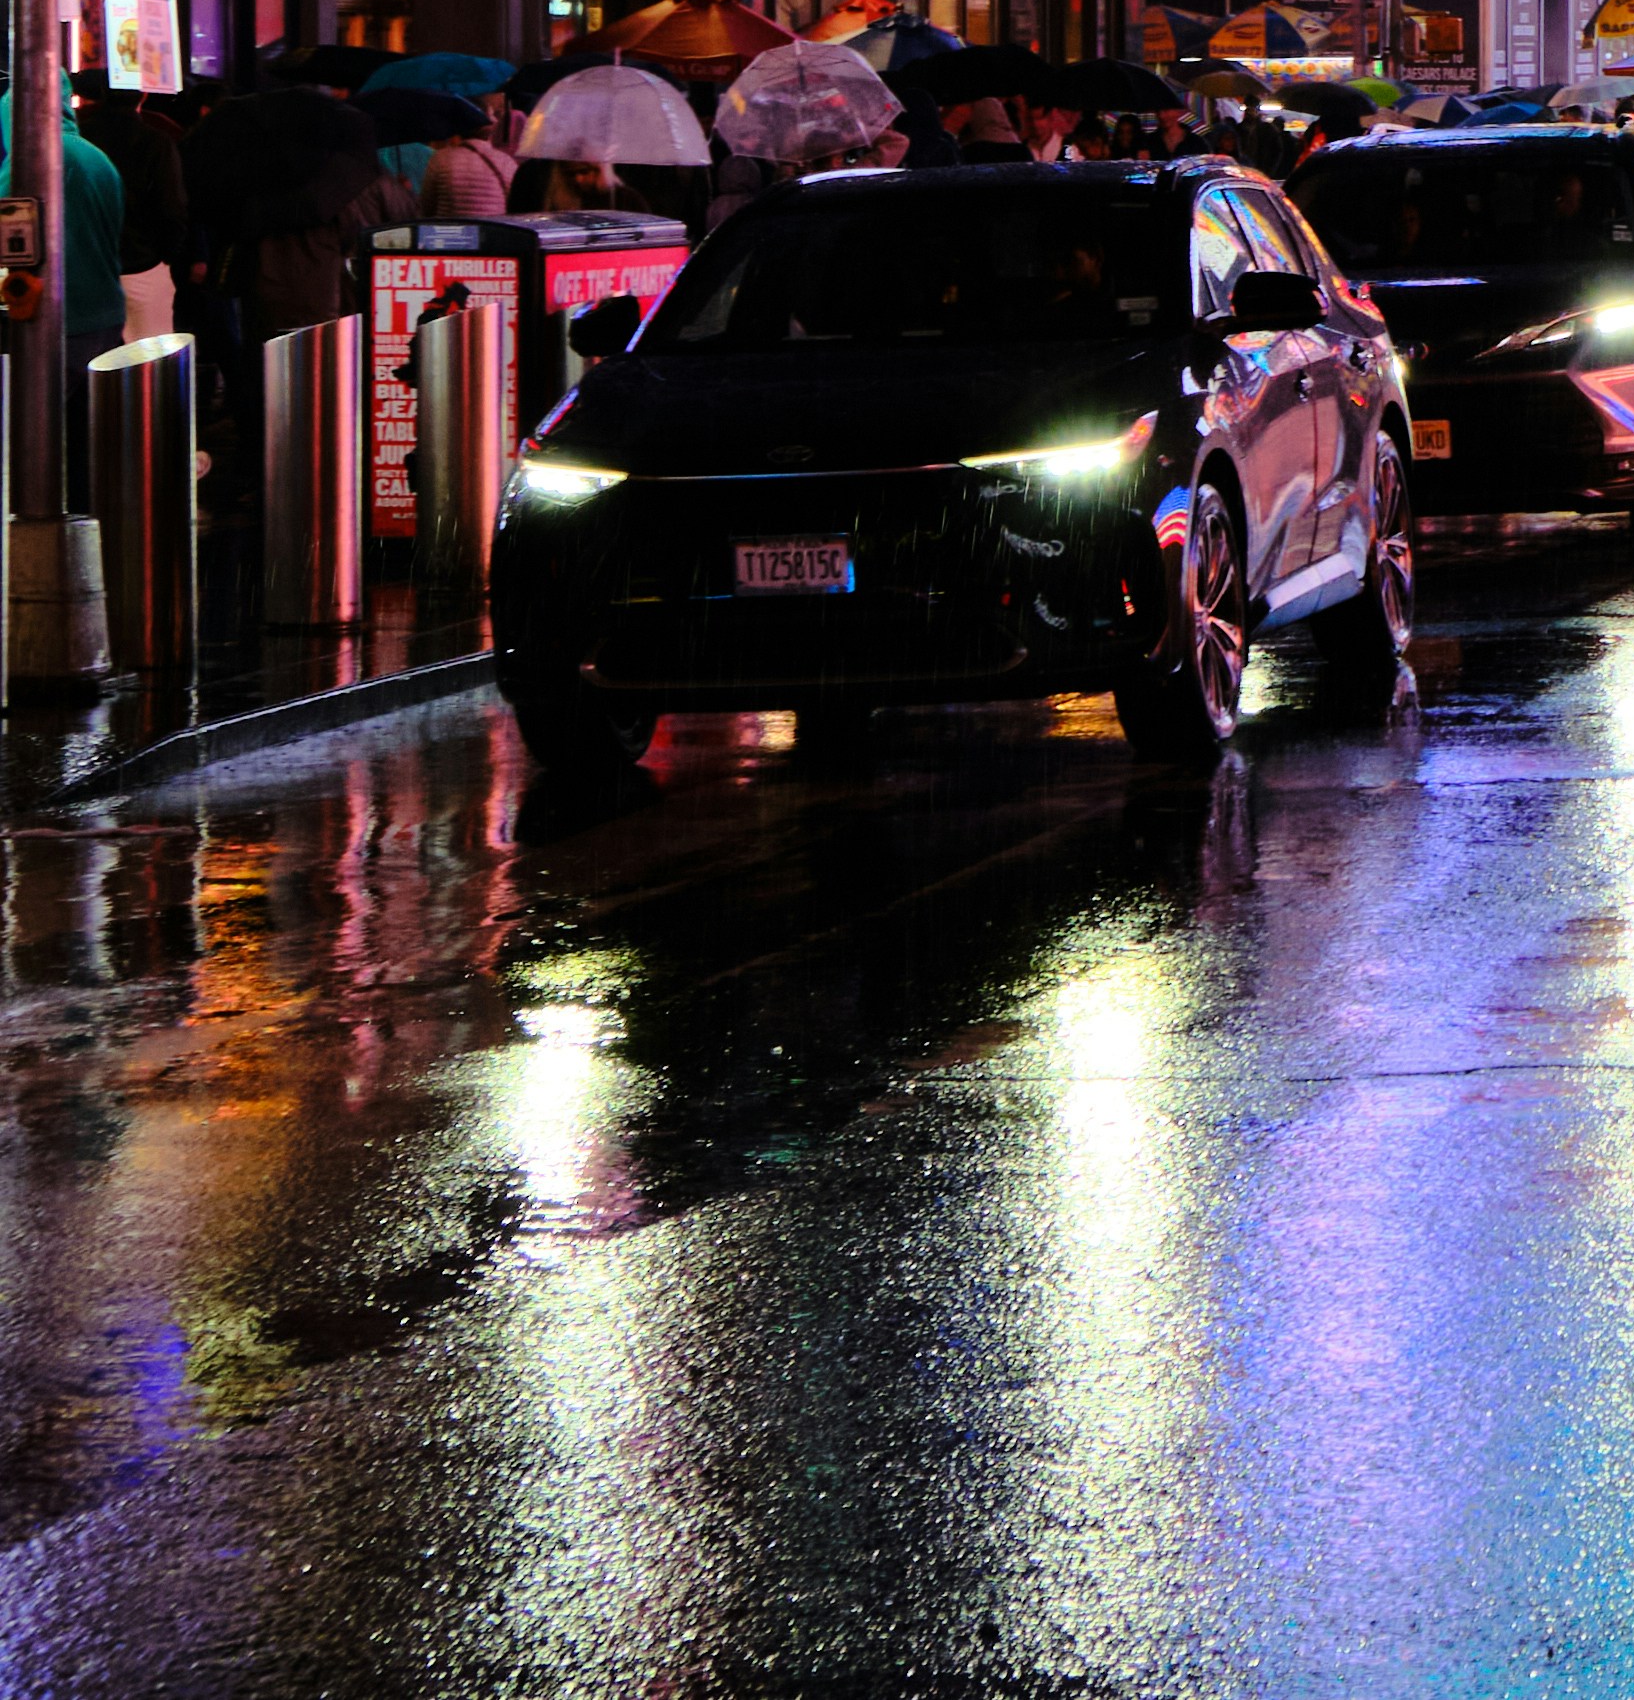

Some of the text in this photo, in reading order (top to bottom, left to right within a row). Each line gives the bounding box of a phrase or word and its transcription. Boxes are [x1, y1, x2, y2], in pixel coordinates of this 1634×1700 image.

[375, 259, 438, 288] BEAT
[443, 259, 516, 278] THRILLER
[744, 550, 841, 581] T125815C
